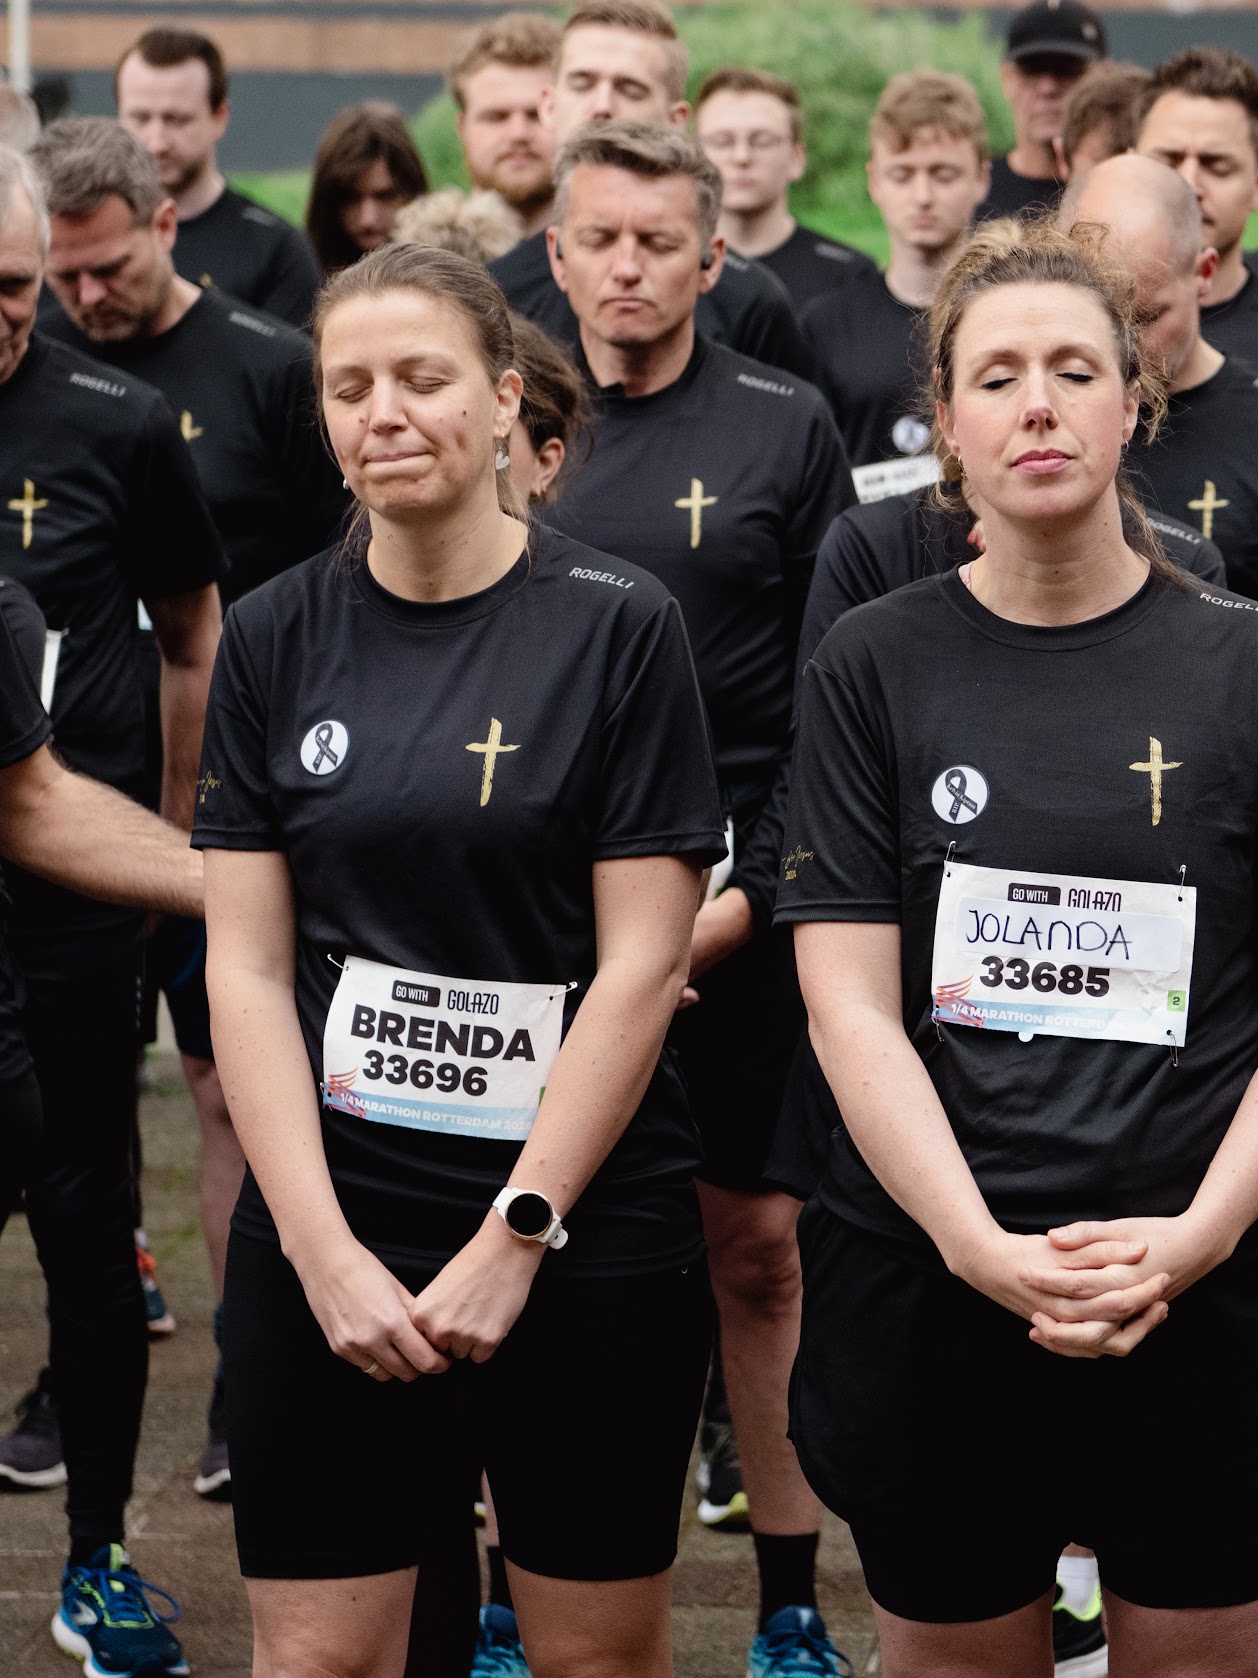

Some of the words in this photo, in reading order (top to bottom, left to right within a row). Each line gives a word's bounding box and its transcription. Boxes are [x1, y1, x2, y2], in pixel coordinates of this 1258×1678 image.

[569, 567, 634, 589] ROGELLI
[1012, 887, 1025, 901] GO
[1026, 889, 1049, 903] WITH
[1067, 888, 1122, 912] GOLAZO
[979, 955, 1110, 998] 33685
[395, 985, 407, 998] GO
[408, 987, 429, 1003] WITH
[447, 989, 499, 1015] GOLAZO
[950, 1003, 969, 1015] 1/4
[969, 1006, 1044, 1025] MARATHON
[350, 1003, 536, 1062] BRENDA
[362, 1049, 489, 1096] 33696
[340, 1092, 354, 1107] 1/4
[355, 1096, 424, 1120] MARATHON
[423, 1110, 502, 1130] ROTTERDAM
